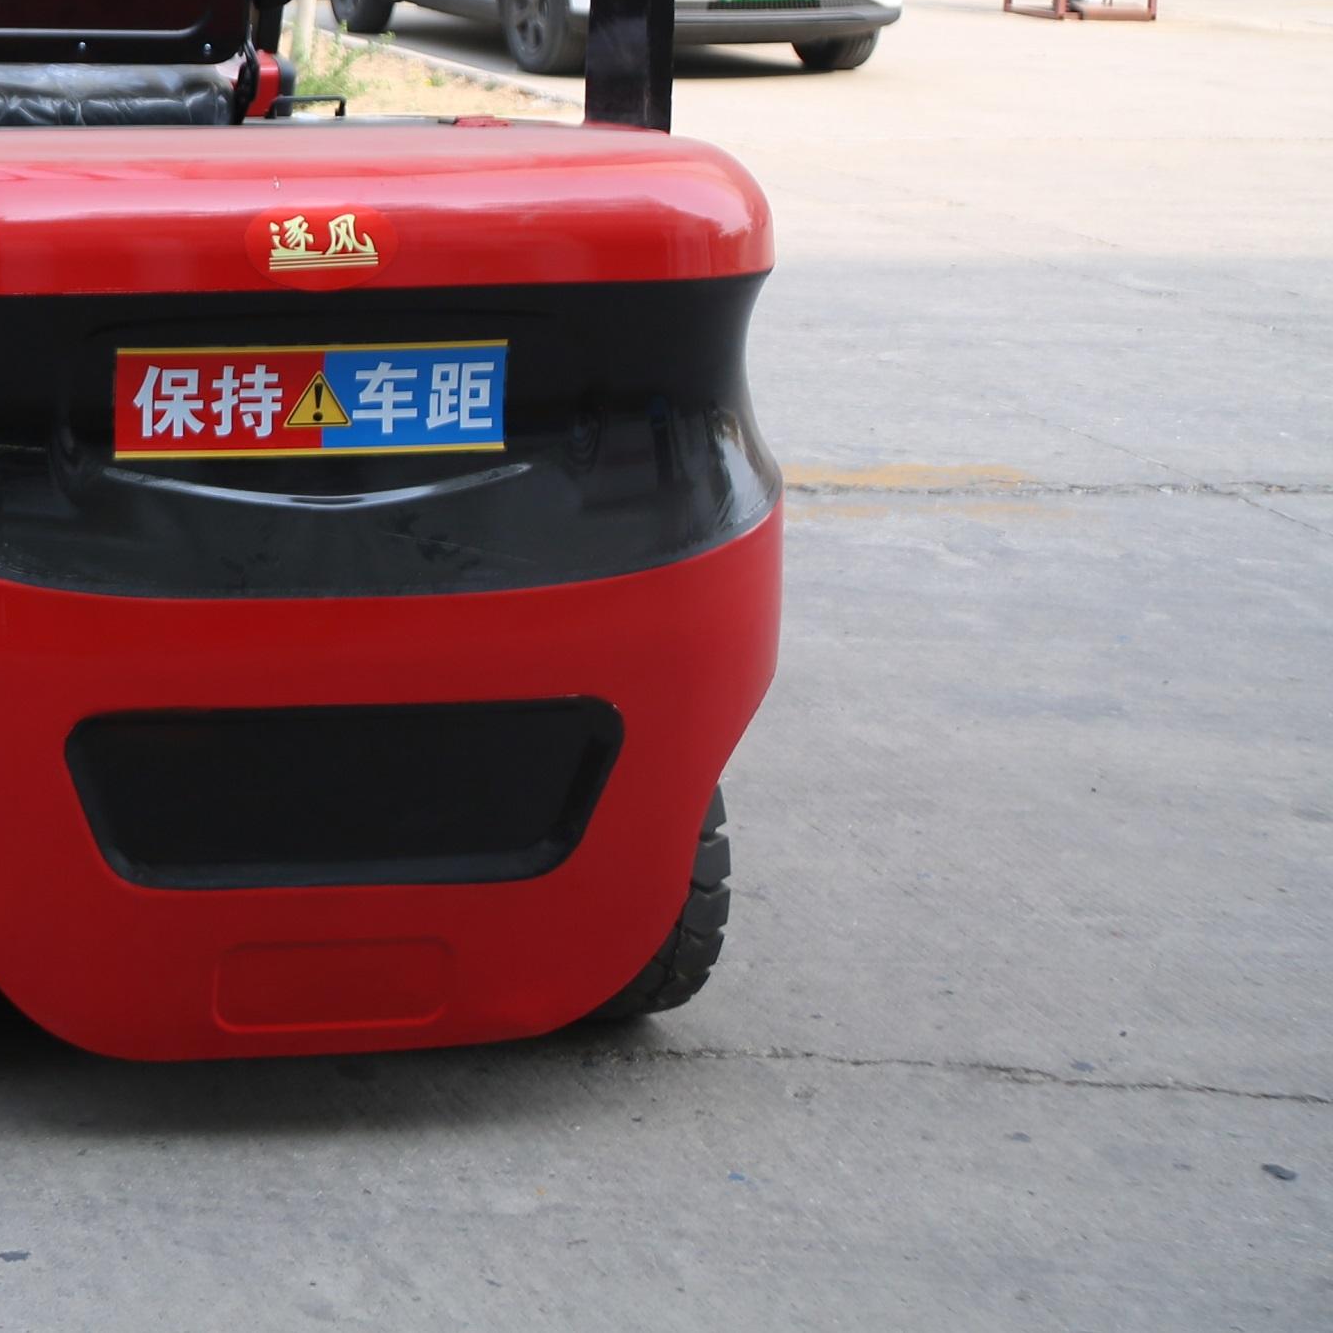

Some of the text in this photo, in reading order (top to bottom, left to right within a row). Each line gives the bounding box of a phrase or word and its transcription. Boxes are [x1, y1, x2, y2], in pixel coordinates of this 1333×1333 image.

[268, 212, 376, 256] 逐风
[133, 361, 496, 438] 保持 车距
